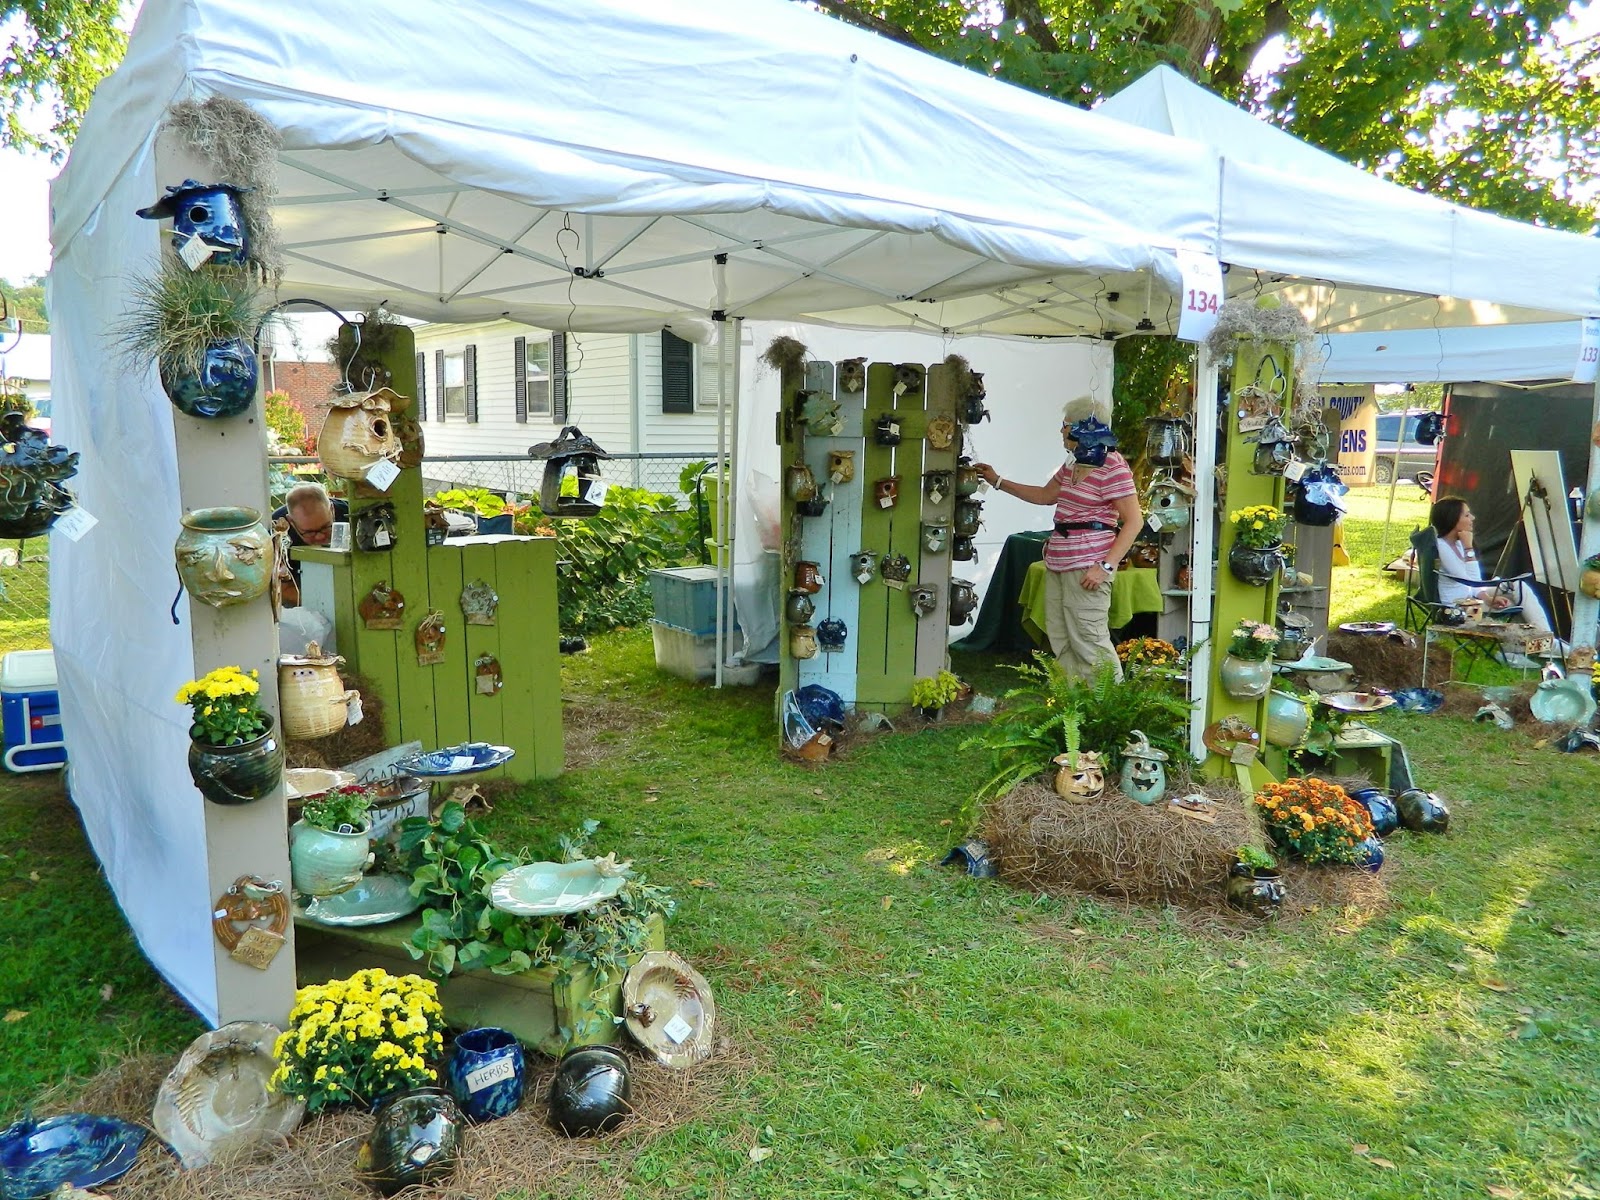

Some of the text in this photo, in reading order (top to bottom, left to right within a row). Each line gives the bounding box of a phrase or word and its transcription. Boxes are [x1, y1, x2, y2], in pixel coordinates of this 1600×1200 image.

[1187, 288, 1218, 315] 134
[1582, 346, 1599, 363] 133
[1340, 429, 1367, 453] ENS
[474, 1062, 510, 1086] HERBS
